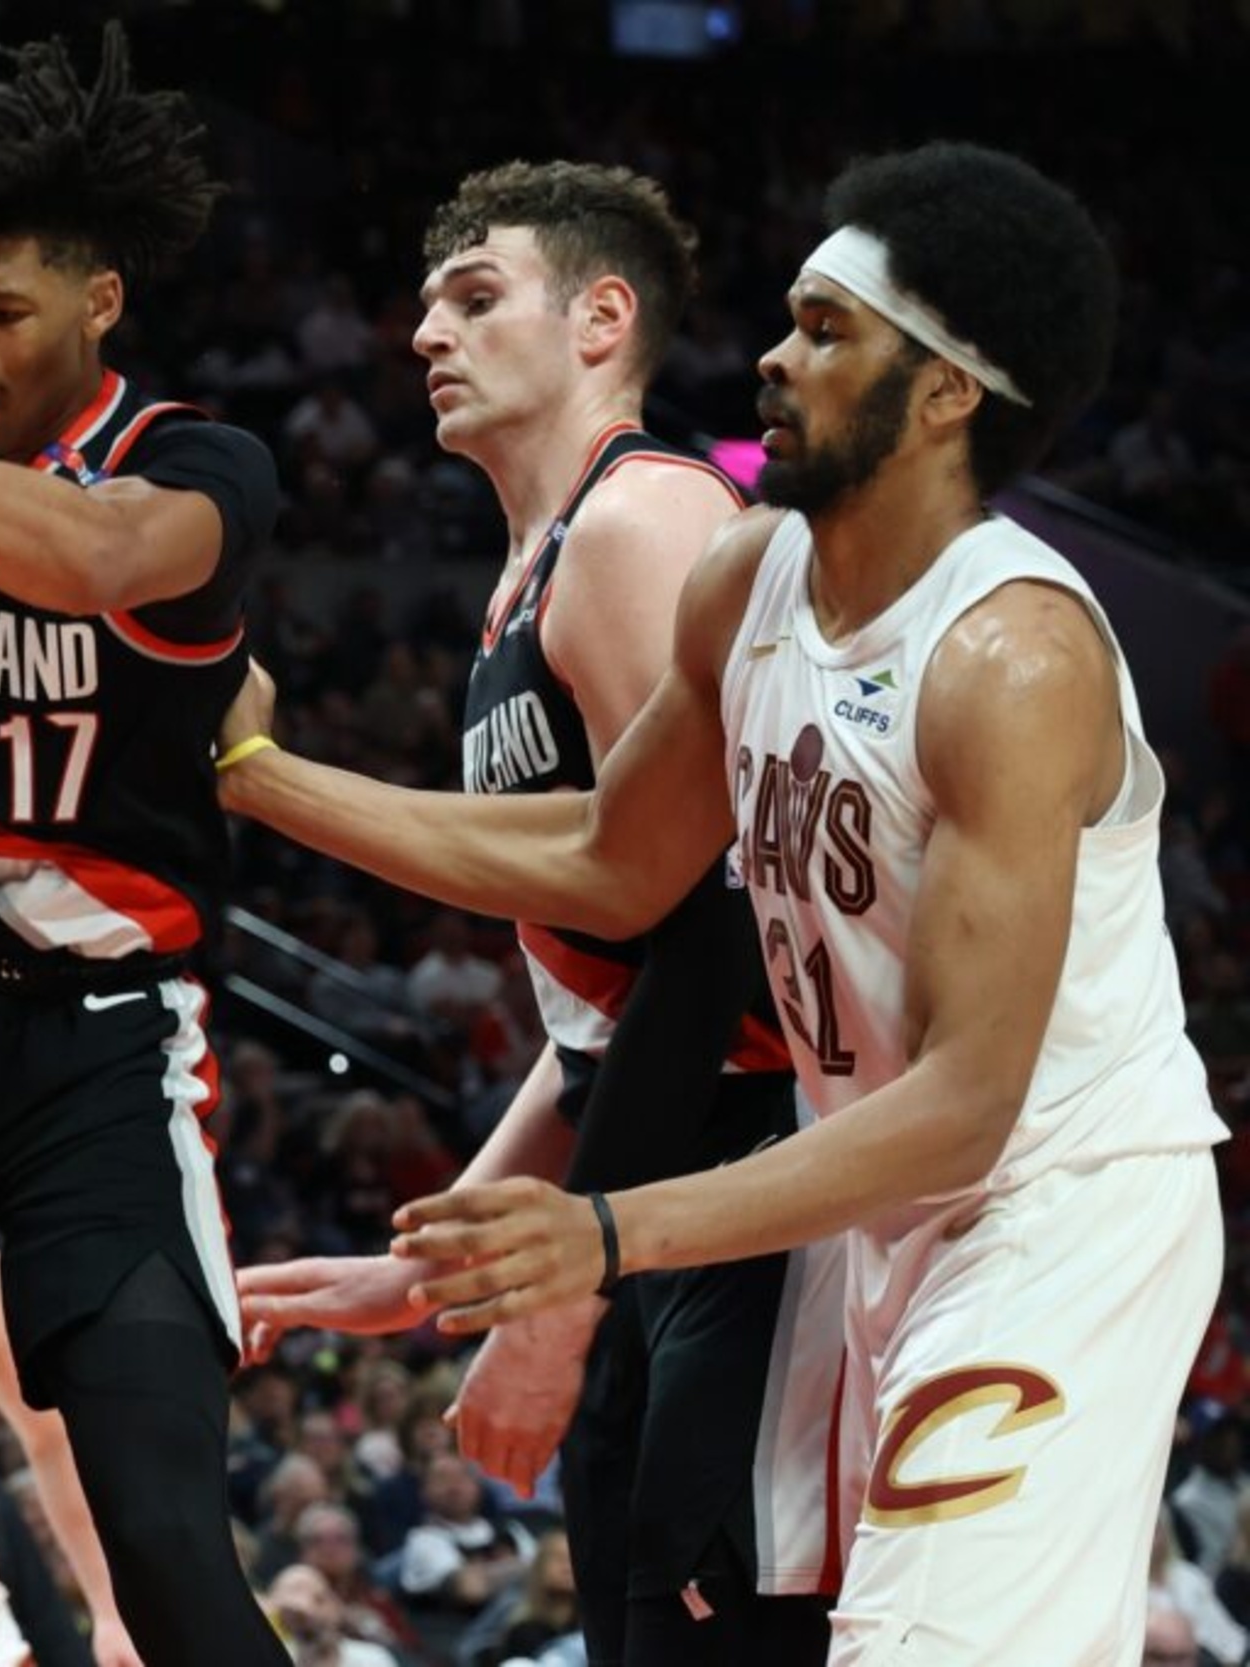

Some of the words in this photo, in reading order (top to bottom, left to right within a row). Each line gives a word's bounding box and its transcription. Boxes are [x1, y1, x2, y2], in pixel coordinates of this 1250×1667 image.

[833, 699, 891, 733] CLIFFS
[765, 916, 857, 1078] 31
[862, 1360, 1068, 1530] C
